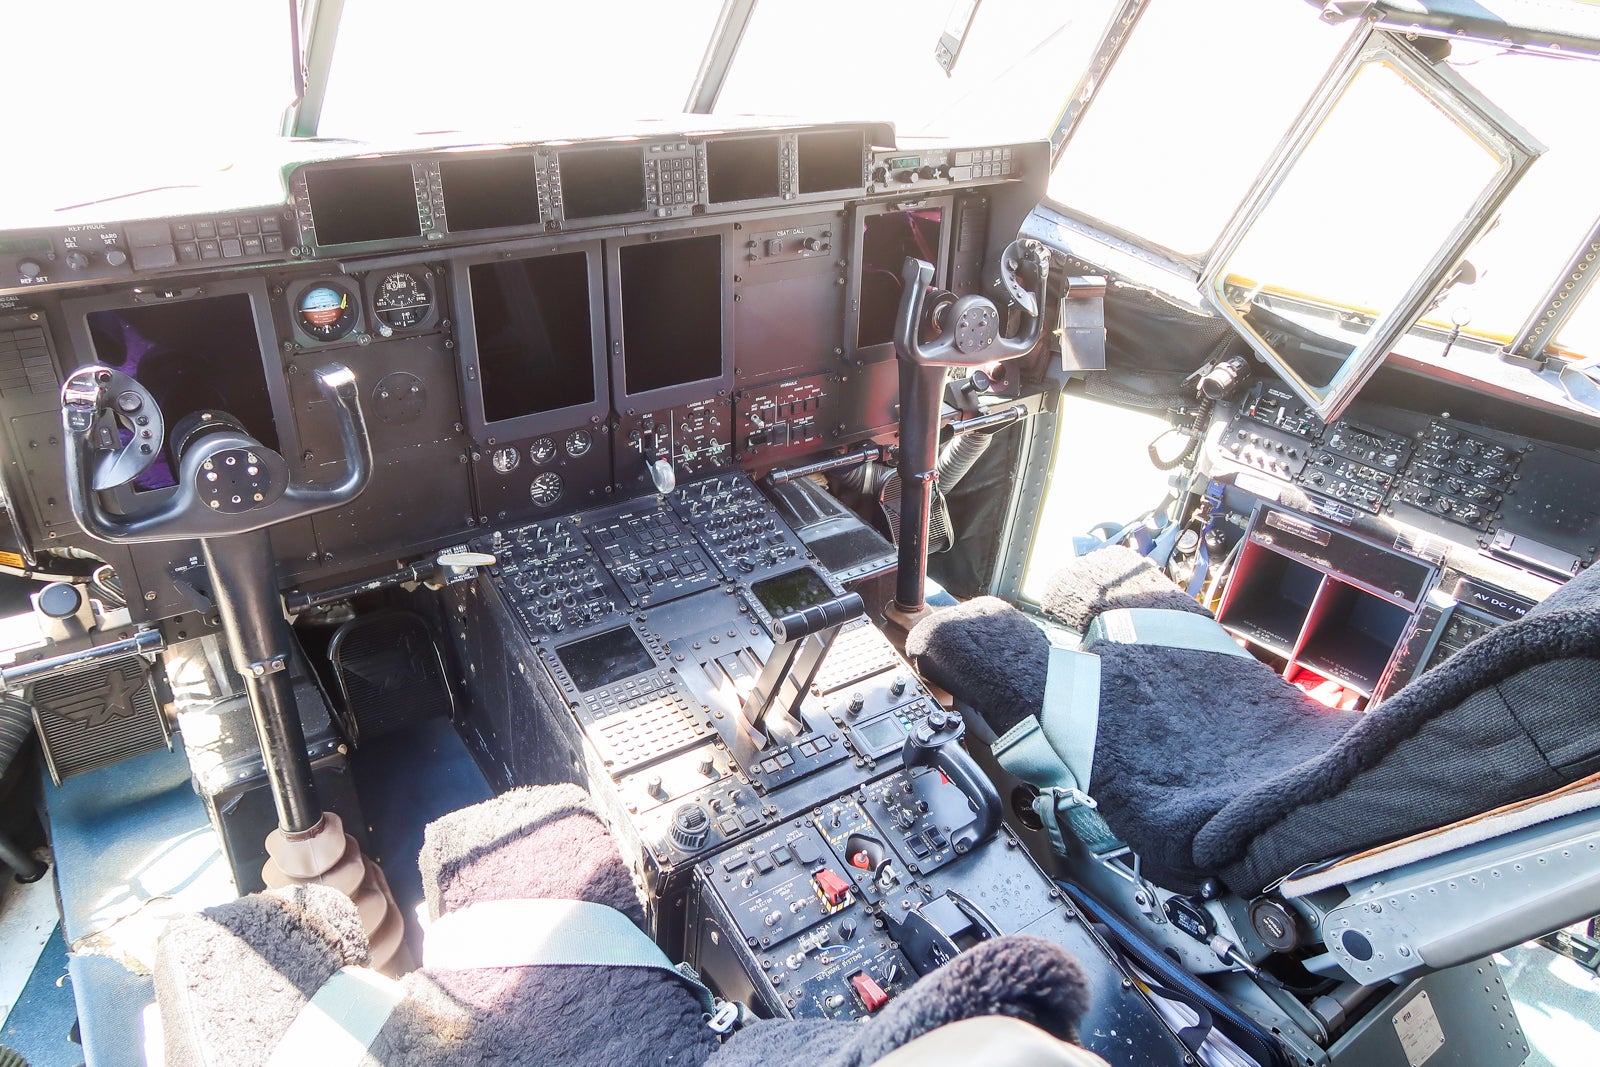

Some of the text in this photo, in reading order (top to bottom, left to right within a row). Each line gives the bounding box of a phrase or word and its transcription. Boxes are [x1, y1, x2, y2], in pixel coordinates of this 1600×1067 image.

[1473, 592, 1489, 600] AV
[1491, 598, 1507, 608] DC
[1335, 664, 1368, 680] CAPACITY
[754, 830, 776, 842] DELIVERY
[816, 954, 862, 981] DEFENSIVE SYSTEMS
